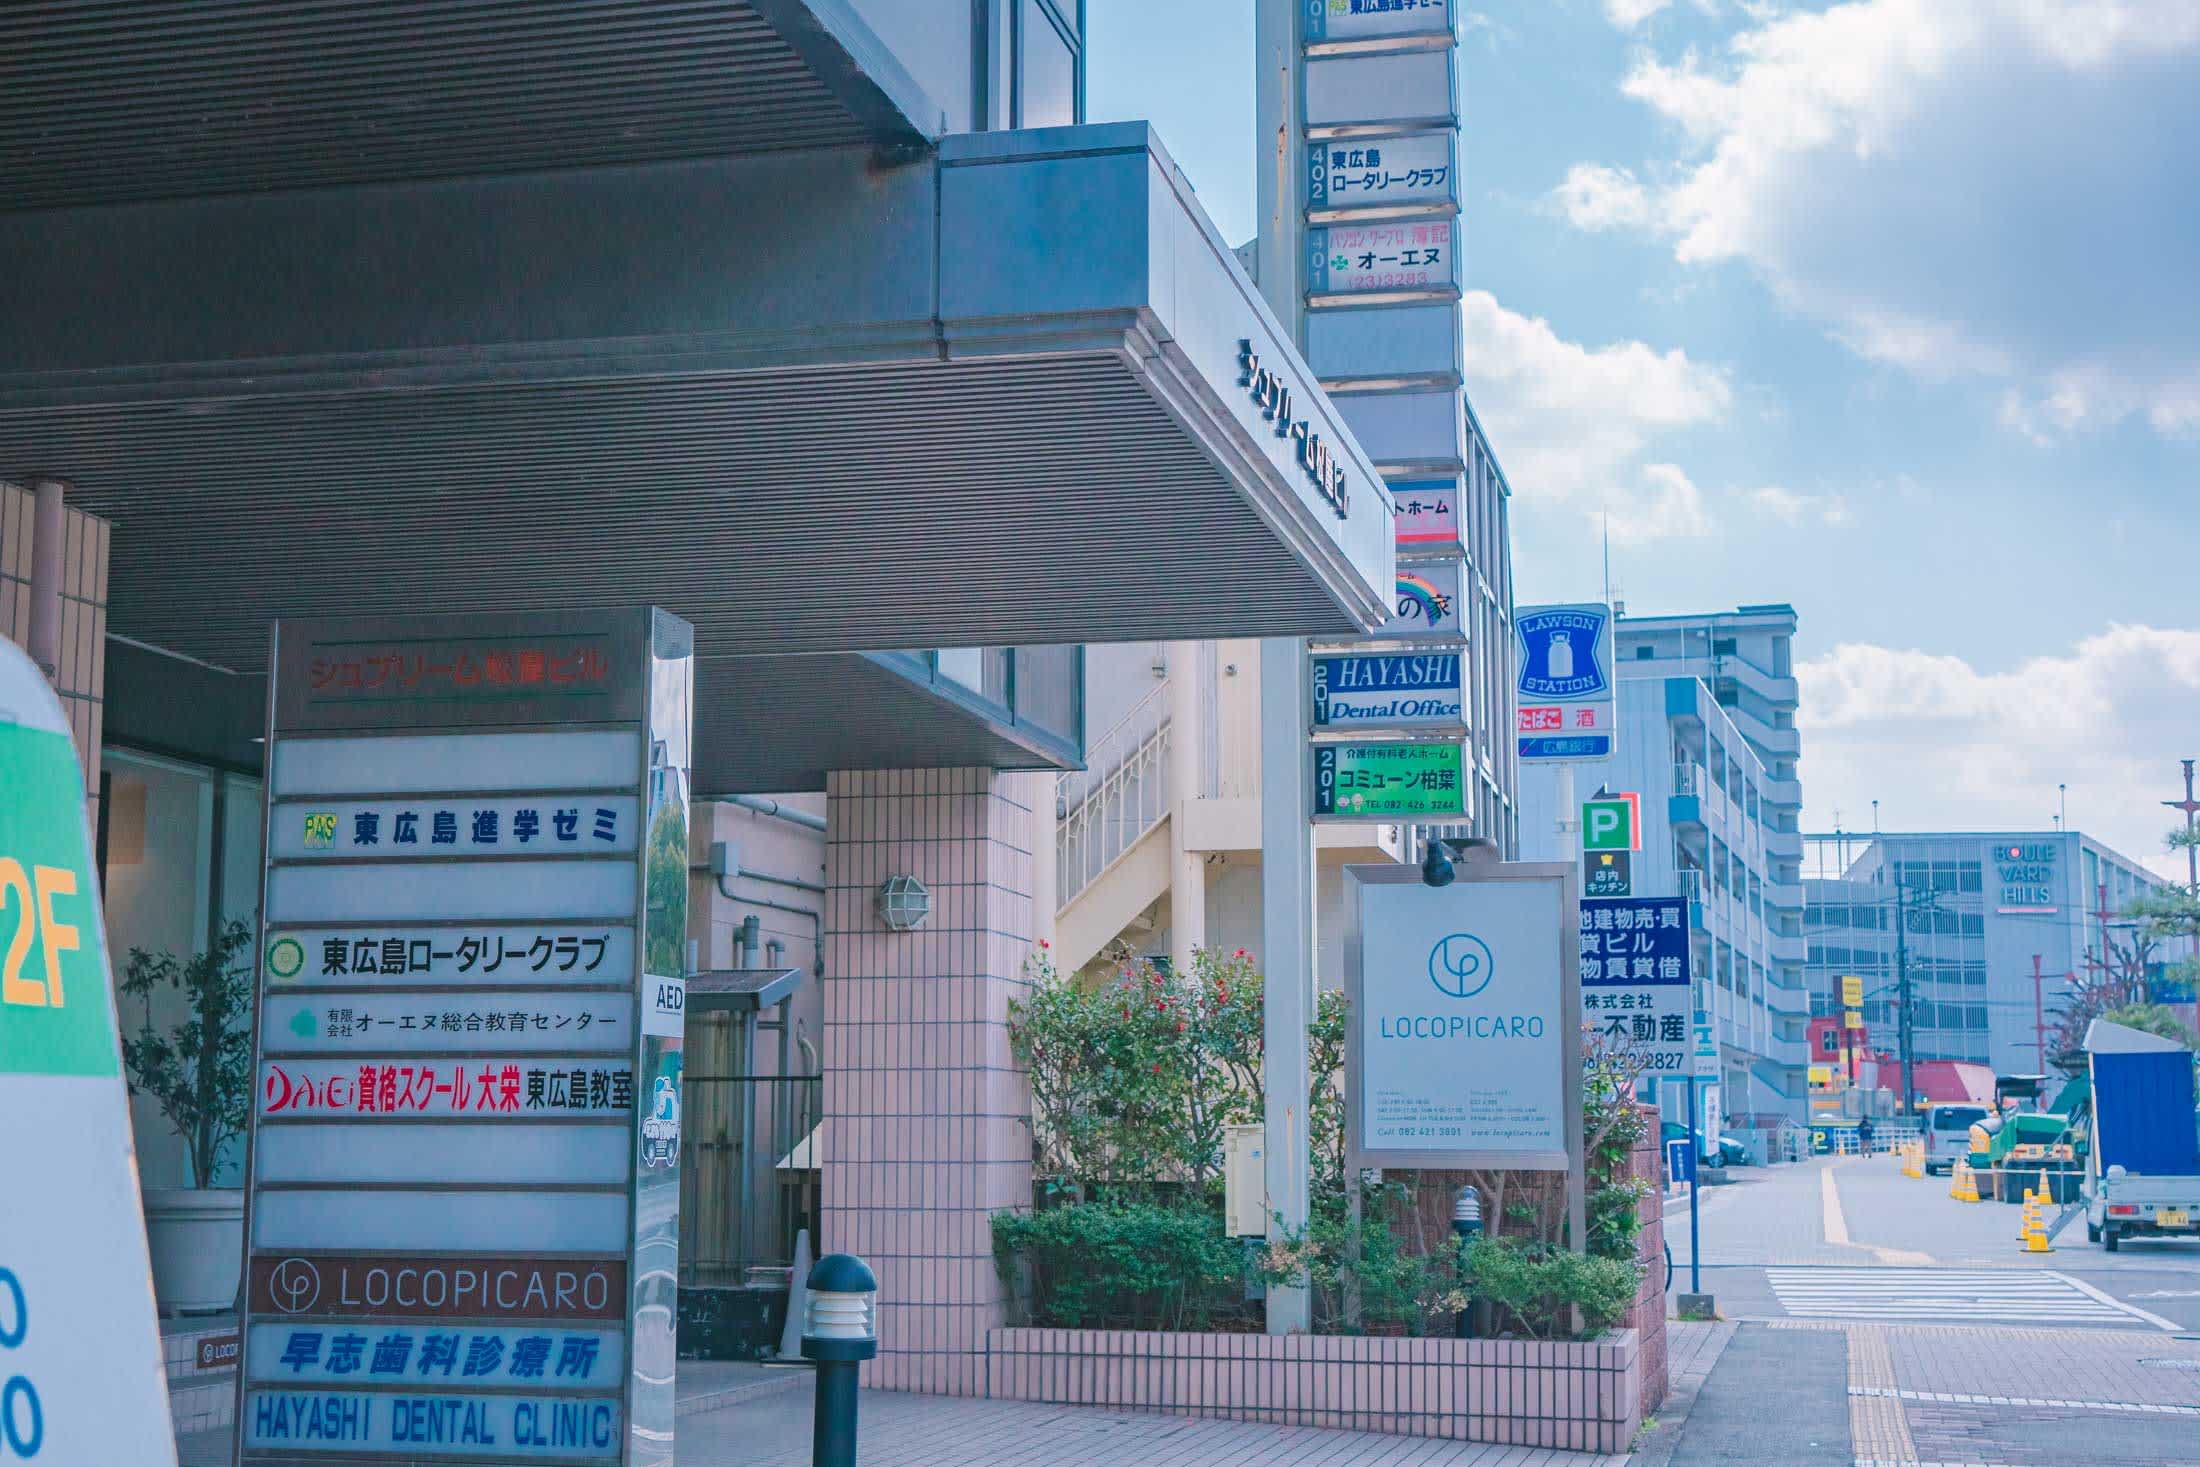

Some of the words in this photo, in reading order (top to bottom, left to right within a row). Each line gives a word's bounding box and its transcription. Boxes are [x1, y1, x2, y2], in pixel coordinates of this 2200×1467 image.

[1332, 149, 1380, 170] 東広島
[1311, 148, 1325, 198] 402
[1333, 165, 1448, 192] ロータリークラブ
[1358, 248, 1440, 270] オーエヌ
[1525, 614, 1598, 634] LAWSON
[1338, 655, 1456, 688] HAYASHI
[1315, 664, 1328, 720] 201
[1526, 674, 1596, 693] STATION
[1332, 700, 1401, 720] Dental
[1402, 698, 1461, 718] Office
[1518, 709, 1560, 729] たばこ
[1576, 709, 1595, 727] 酒
[1321, 750, 1333, 807] 201
[1340, 769, 1456, 790] コミューン柏葉
[353, 809, 617, 846] 東広島進学ゼミ
[1591, 808, 1618, 842] P
[1587, 882, 1628, 894] キッチン
[321, 934, 612, 976] 東広島ロータリークラブ
[656, 984, 683, 1010] AED
[1584, 993, 1654, 1009] 株式会社
[327, 1009, 353, 1023] 有限
[356, 1010, 617, 1032] オーエヌ総合教育センター
[1381, 1016, 1544, 1039] LOCOPICARO
[327, 1023, 353, 1038] 会社
[341, 1266, 608, 1310] LOCOPICARO
[279, 1332, 601, 1379] 早志歯科診療所
[255, 1395, 370, 1440] HAYASHI
[392, 1399, 495, 1445] DENTAL
[513, 1402, 611, 1449] CLINIC
